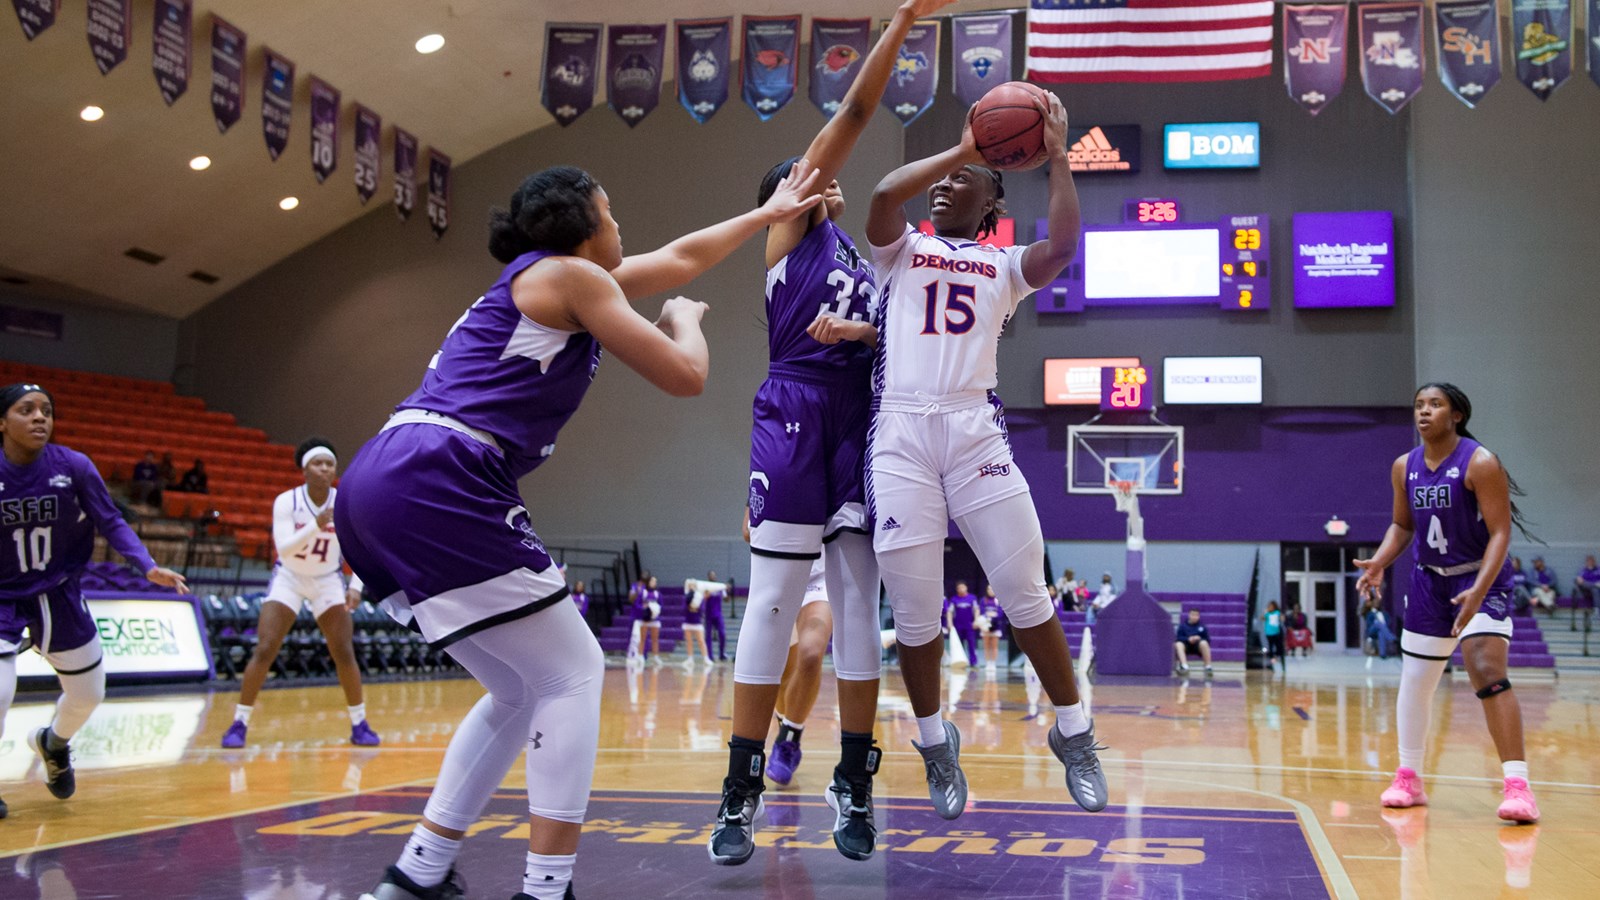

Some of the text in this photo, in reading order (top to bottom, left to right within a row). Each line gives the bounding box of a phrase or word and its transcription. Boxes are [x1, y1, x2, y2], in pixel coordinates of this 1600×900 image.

[1301, 39, 1329, 62] N
[313, 142, 333, 169] 10
[1068, 149, 1120, 162] adidas
[1193, 135, 1254, 155] BOM
[355, 164, 376, 190] 25
[395, 184, 412, 209] 33
[428, 203, 447, 228] 45
[1138, 202, 1176, 222] 3:26
[1231, 215, 1258, 226] GUEST
[1234, 229, 1261, 250] 23
[910, 254, 997, 279] DEMONS
[1243, 261, 1257, 277] 4
[816, 268, 879, 323] 33
[920, 279, 976, 335] 15
[1239, 290, 1252, 307] 2
[1115, 367, 1147, 384] 3:26
[1111, 383, 1141, 407] 20
[978, 462, 1010, 478] NSU
[1414, 484, 1452, 509] SFA
[1, 495, 58, 525] SFA
[882, 523, 901, 531] adidas
[1427, 514, 1448, 555] 4
[13, 526, 52, 573] 10
[97, 618, 176, 640] EXGEN
[101, 643, 180, 656] TCHITOCHES
